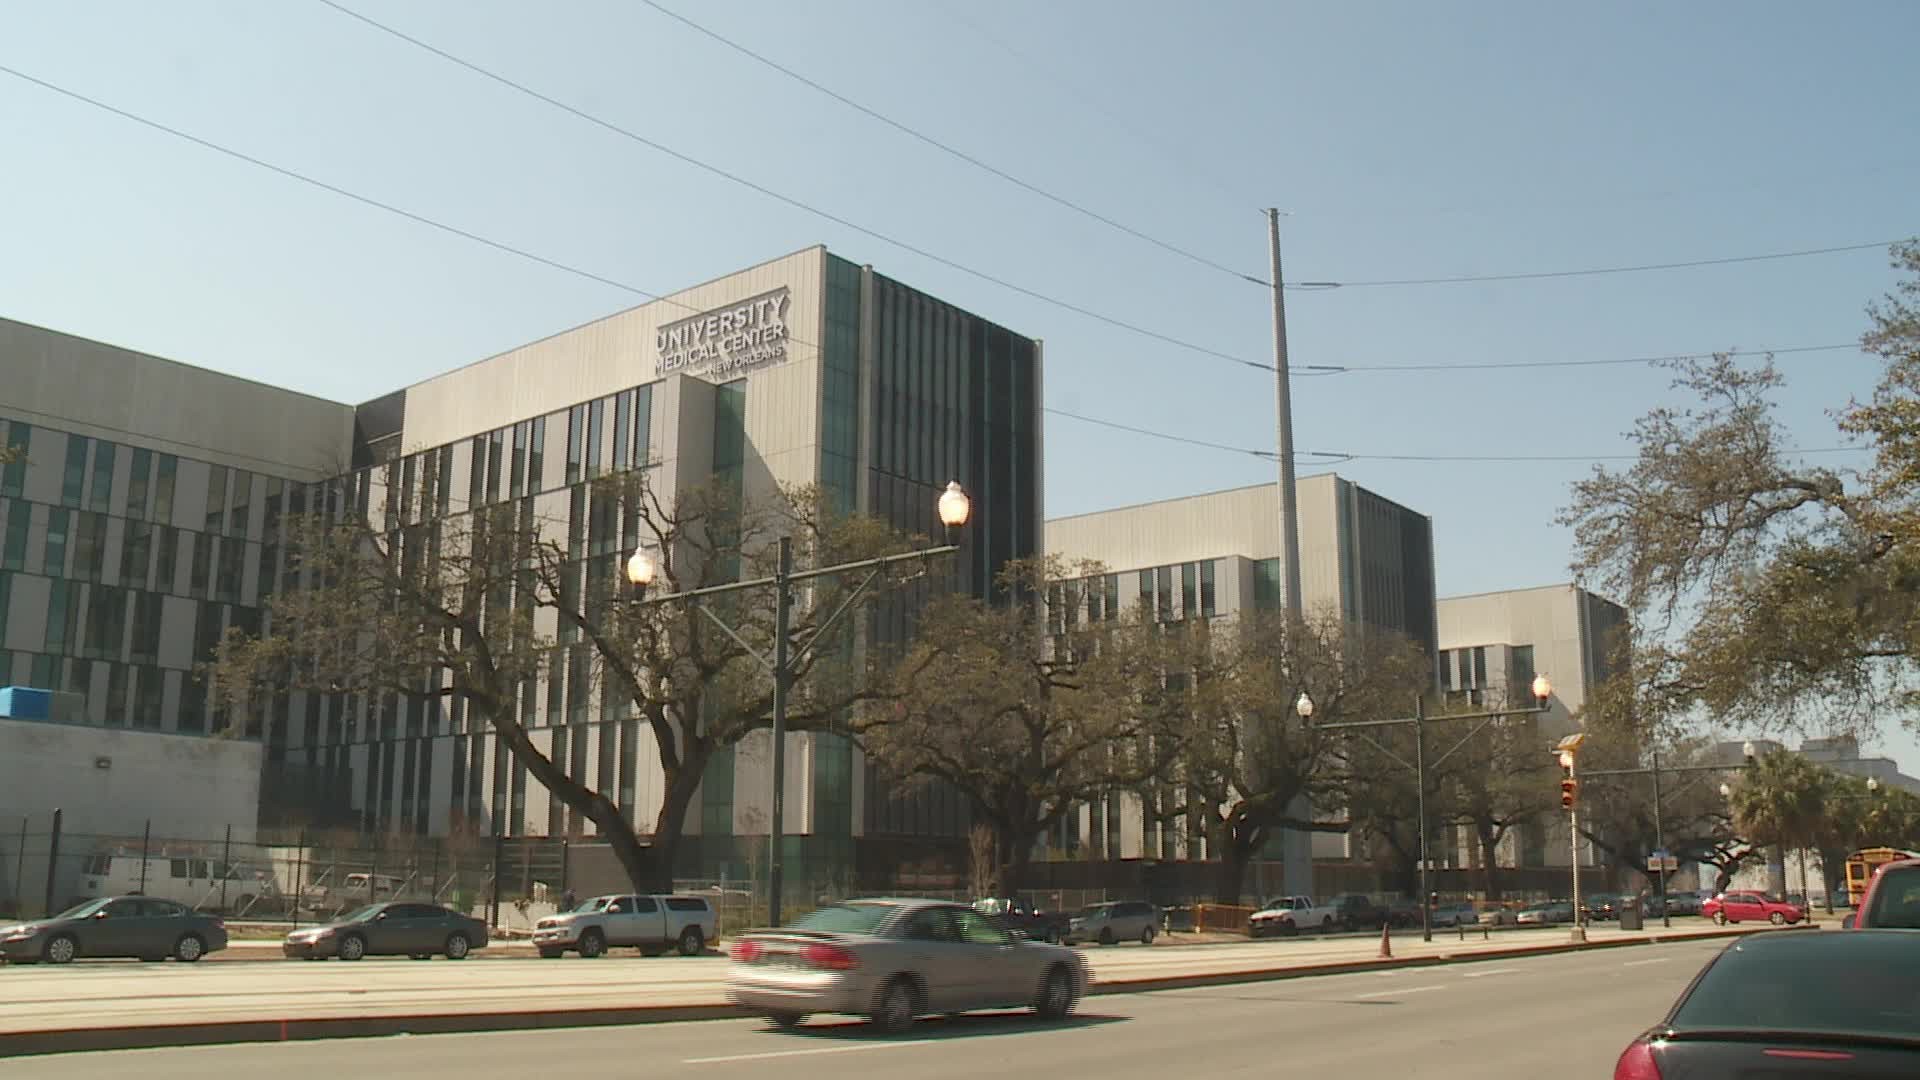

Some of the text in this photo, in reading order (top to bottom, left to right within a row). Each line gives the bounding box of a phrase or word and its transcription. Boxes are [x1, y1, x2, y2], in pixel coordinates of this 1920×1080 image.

[655, 320, 784, 375] MEDICAL CENTER
[656, 294, 786, 352] UNIVERSITY
[708, 344, 784, 376] NEW ORLEANS
